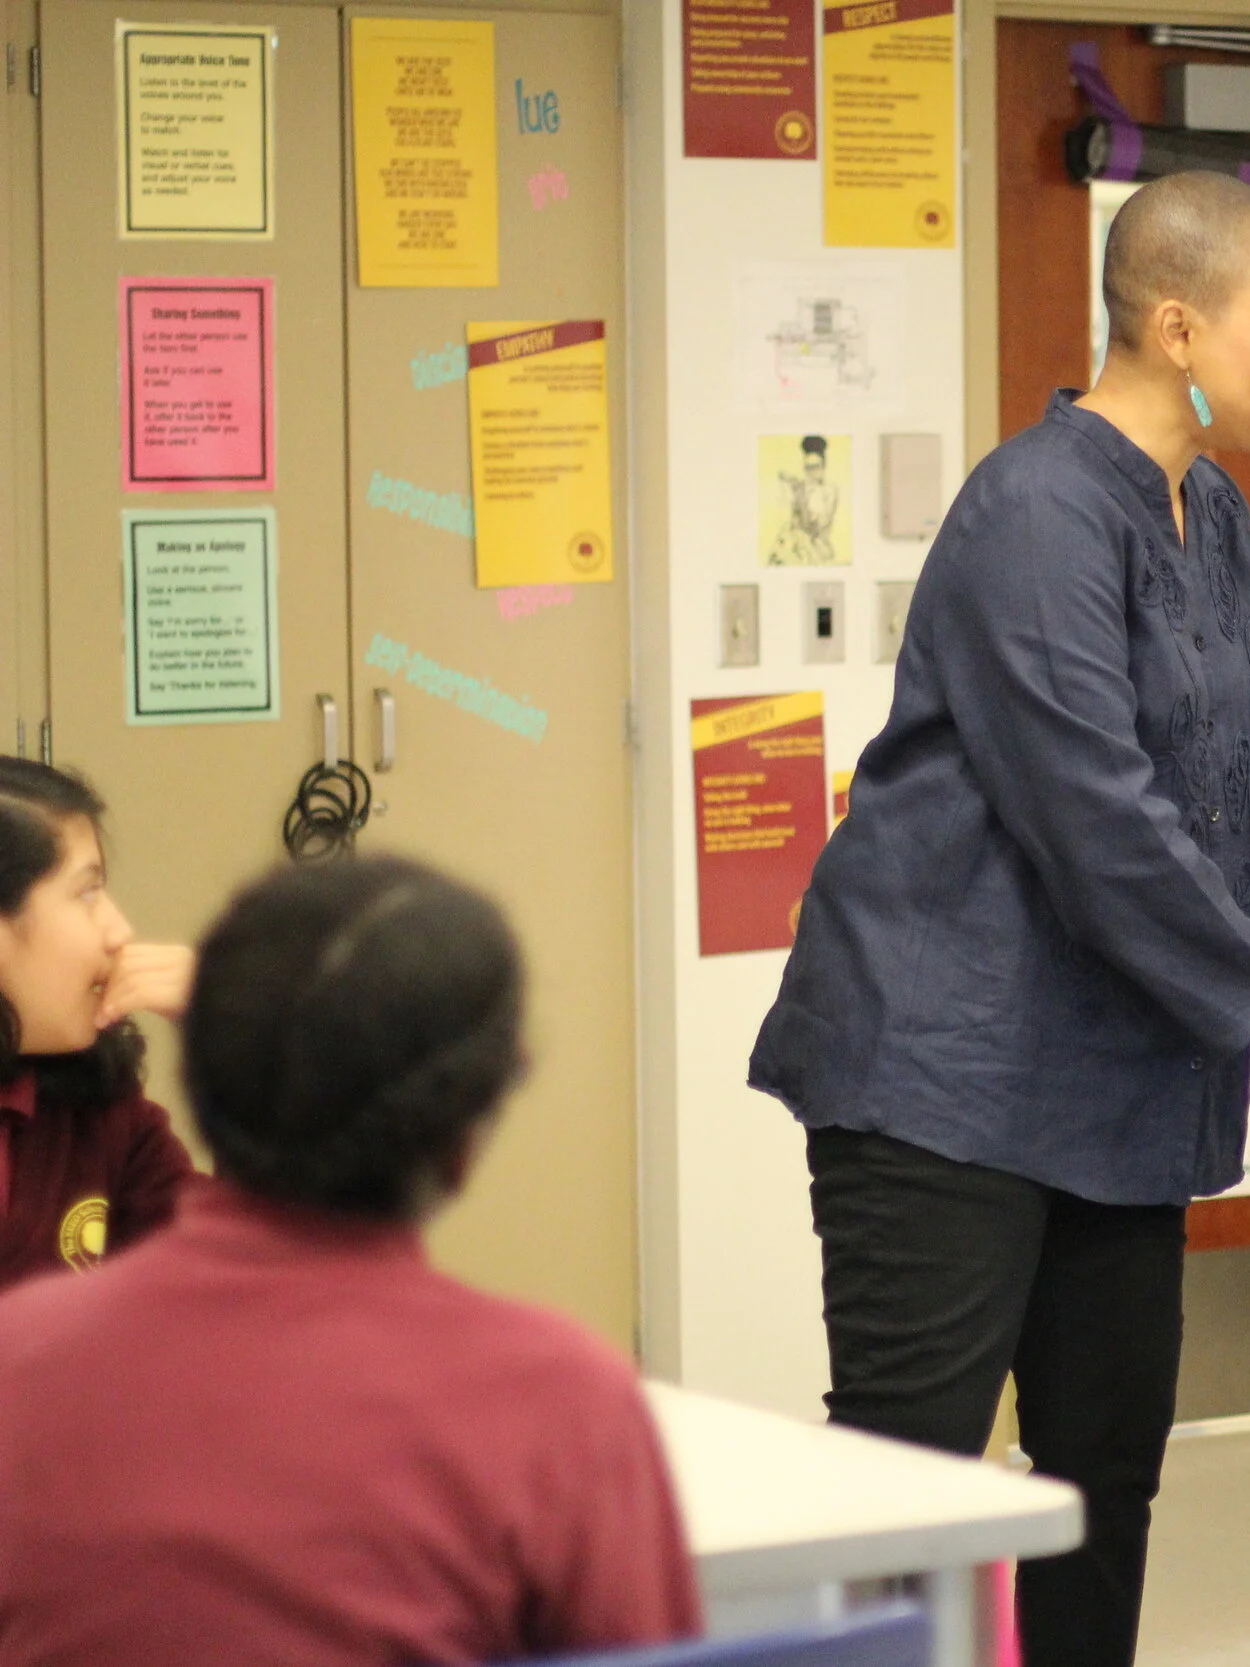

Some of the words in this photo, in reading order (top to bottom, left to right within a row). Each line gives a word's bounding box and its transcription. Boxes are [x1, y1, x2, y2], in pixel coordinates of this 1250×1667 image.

[151, 308, 187, 320] Sharing
[156, 541, 191, 554] Making
[712, 704, 775, 737] INTEGRITY
